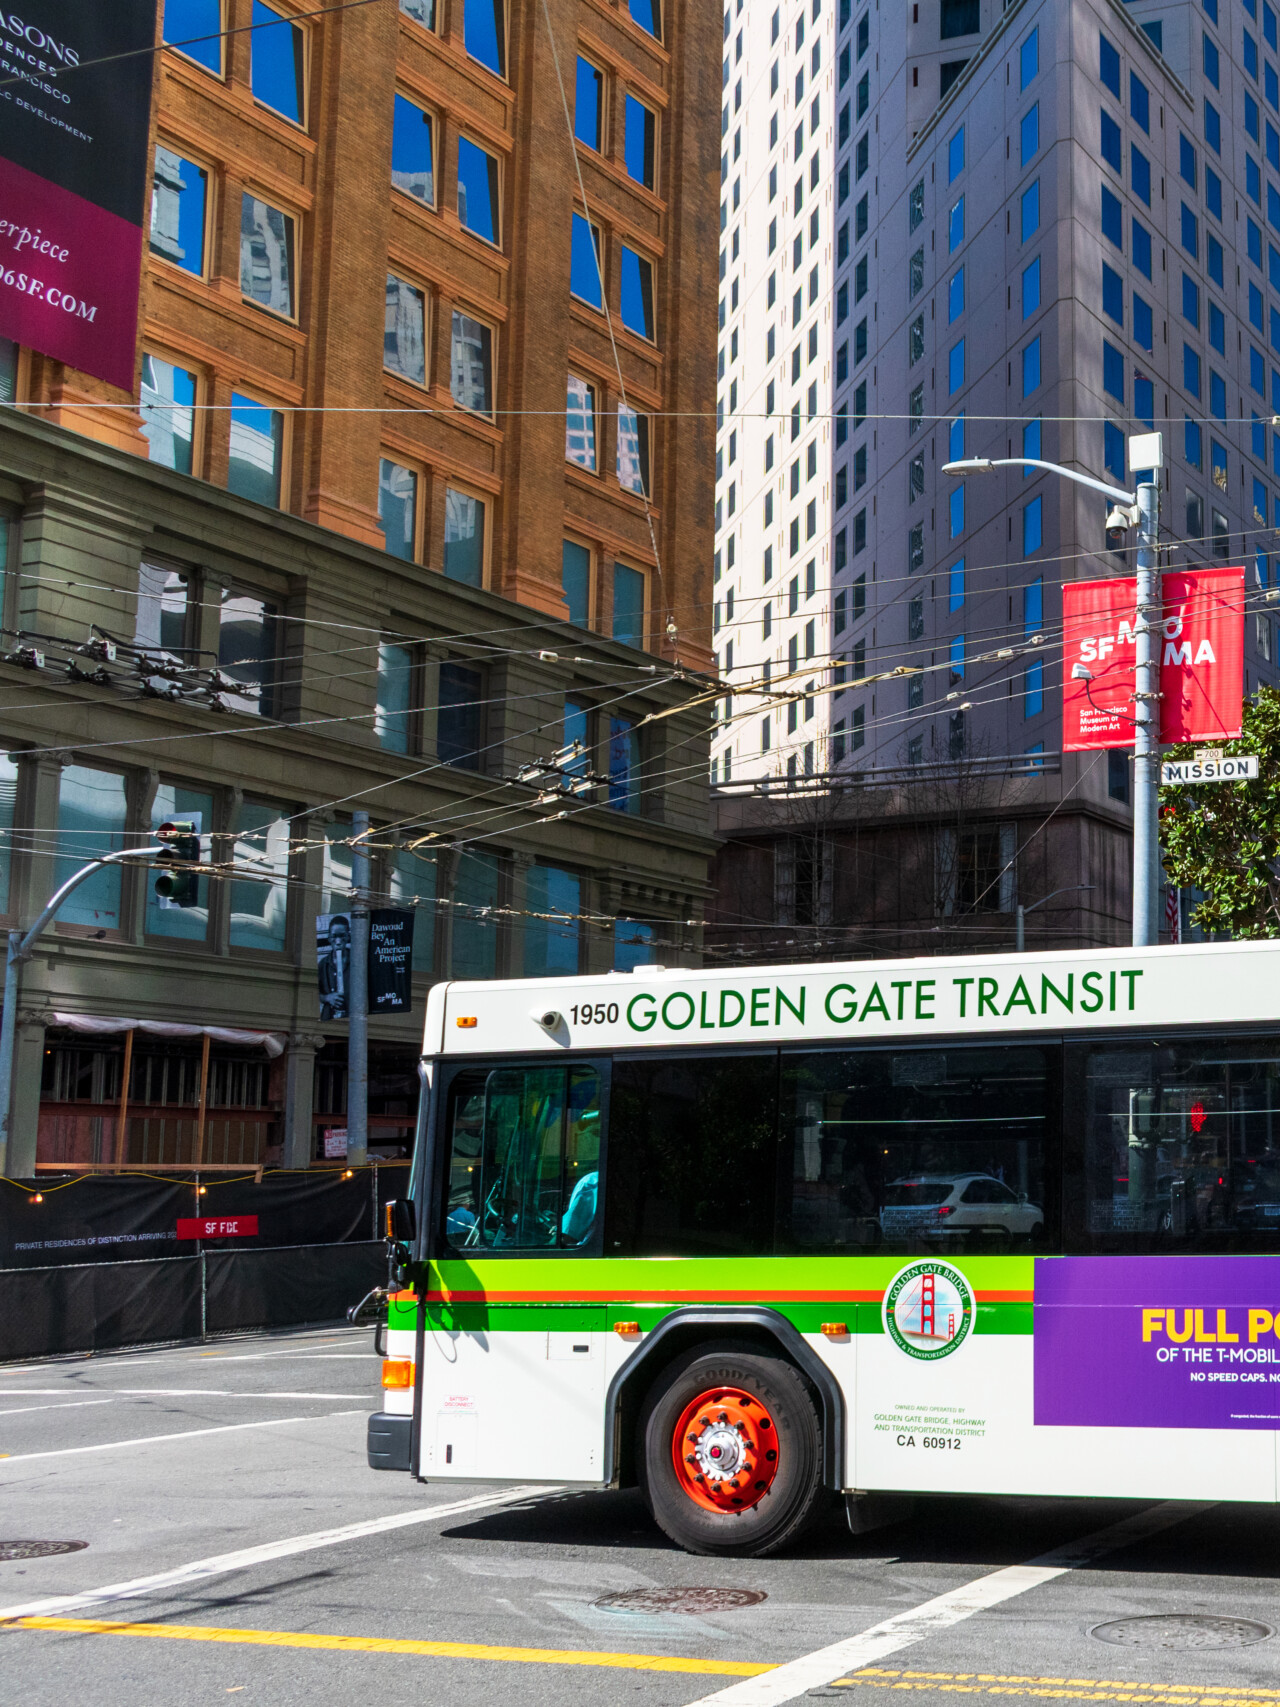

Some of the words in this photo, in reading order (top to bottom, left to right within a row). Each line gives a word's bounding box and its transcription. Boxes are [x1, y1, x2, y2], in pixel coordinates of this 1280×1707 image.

[16, 97, 93, 143] DEVELOPMENT
[1080, 709, 1093, 717] San
[1080, 716, 1110, 725] Museum
[1080, 725, 1107, 733] Modern
[1205, 750, 1219, 758] 700
[1168, 761, 1248, 780] MISSION
[372, 922, 403, 931] Dawoud
[371, 932, 385, 941] Bey
[384, 938, 395, 946] An
[374, 946, 410, 954] American
[379, 954, 405, 963] Project
[570, 1003, 619, 1025] 1950
[626, 985, 806, 1032] GOLDEN
[824, 979, 936, 1023] GATE
[952, 969, 1144, 1018] TRANSIT
[205, 1222, 217, 1234] SF
[15, 1242, 43, 1250] PRIVATE
[44, 1238, 86, 1248] RESIDENCES
[87, 1237, 97, 1245] OF
[98, 1233, 137, 1244] DISTINCTION
[138, 1231, 166, 1240] ARRIVING
[890, 1267, 919, 1301] GOLDEN
[920, 1264, 942, 1274] GATE
[943, 1269, 969, 1300] BRIDGE
[1142, 1308, 1239, 1343] FULL
[888, 1317, 903, 1346] HIGHWAY
[907, 1342, 957, 1359] TRANSPORTATION
[955, 1317, 970, 1345] DISTRICT
[1156, 1348, 1179, 1363] OF
[1182, 1348, 1213, 1363] THE
[1190, 1372, 1206, 1382] NO
[1208, 1373, 1239, 1382] SPEED
[1240, 1373, 1268, 1383] CAPS.
[874, 1413, 903, 1422] GOLDEN
[904, 1415, 922, 1423] GATE
[953, 1418, 986, 1427] HIGHWAY
[874, 1423, 890, 1431] AND
[892, 1424, 954, 1435] TRANSPORTATION
[955, 1429, 986, 1437] DISTRICT
[896, 1434, 916, 1447] CA
[923, 1436, 961, 1450] 60912
